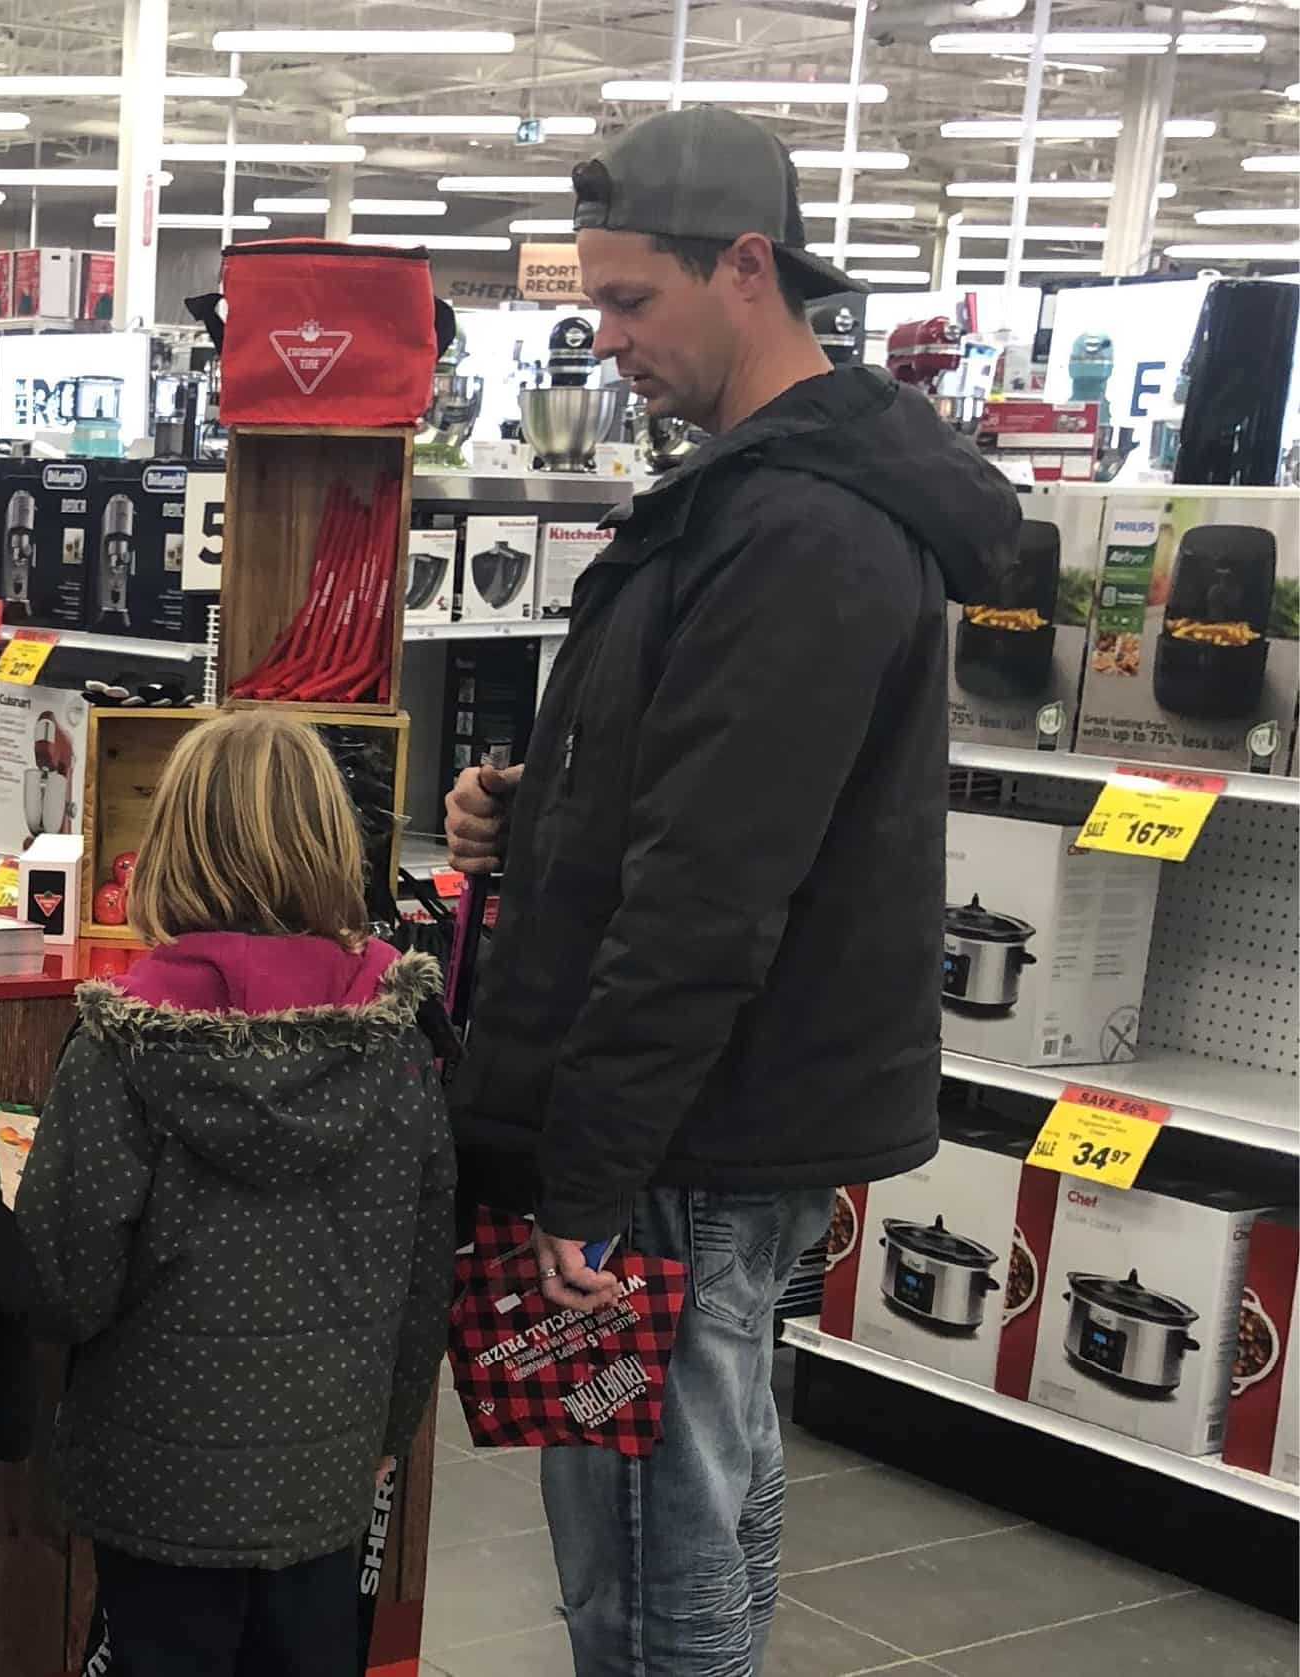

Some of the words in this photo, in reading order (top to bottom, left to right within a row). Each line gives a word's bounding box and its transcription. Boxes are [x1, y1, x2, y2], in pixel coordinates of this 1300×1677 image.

[525, 279, 580, 292] RECRE
[300, 359, 320, 370] TIRE
[549, 527, 613, 541] KitchenA
[1115, 521, 1155, 534] PHILIPS
[1112, 729, 1130, 743] up
[1132, 729, 1147, 742] to
[1125, 819, 1168, 847] 167
[1078, 1092, 1118, 1109] SAVE
[1035, 1141, 1057, 1157] SALE
[1072, 1141, 1111, 1171] 34
[1067, 1190, 1101, 1209] Chef
[617, 1274, 648, 1298] WI
[525, 1308, 592, 1340] PECIAL
[586, 1333, 599, 1348] 5
[474, 1334, 528, 1369] PRIZE!
[594, 1352, 652, 1403] TRIVIA
[559, 1378, 609, 1425] TRAIL
